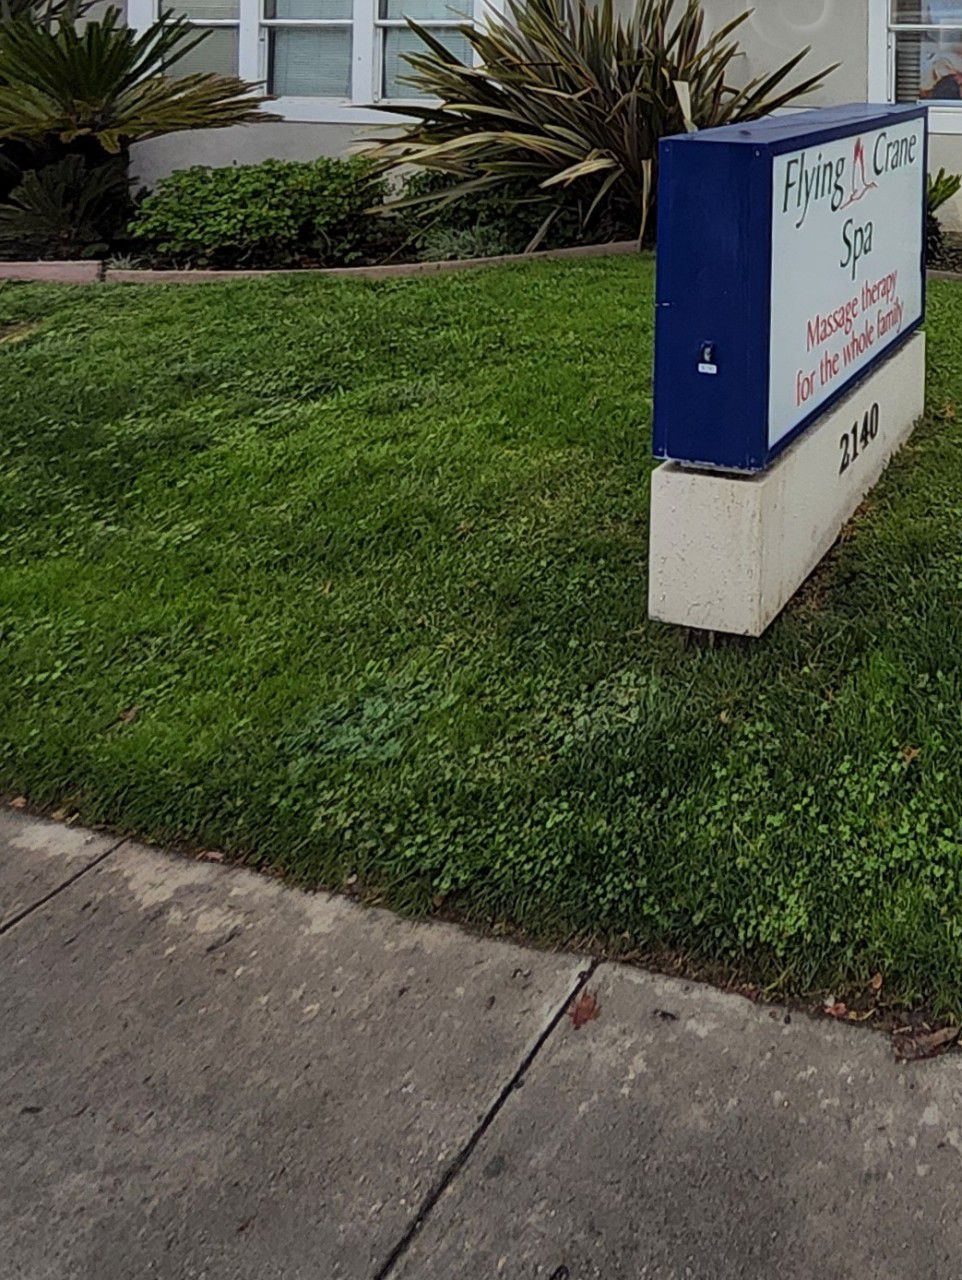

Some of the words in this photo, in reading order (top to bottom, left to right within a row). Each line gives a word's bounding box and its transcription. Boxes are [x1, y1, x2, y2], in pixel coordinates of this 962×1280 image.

[783, 152, 845, 228] Flying
[873, 132, 917, 176] Crane
[840, 218, 873, 280] Spa
[796, 370, 816, 407] for
[820, 350, 840, 386] the
[843, 318, 874, 367] whole
[877, 296, 904, 339] family
[806, 297, 859, 352] Massage
[861, 270, 898, 312] therapy
[839, 403, 879, 474] 2140
